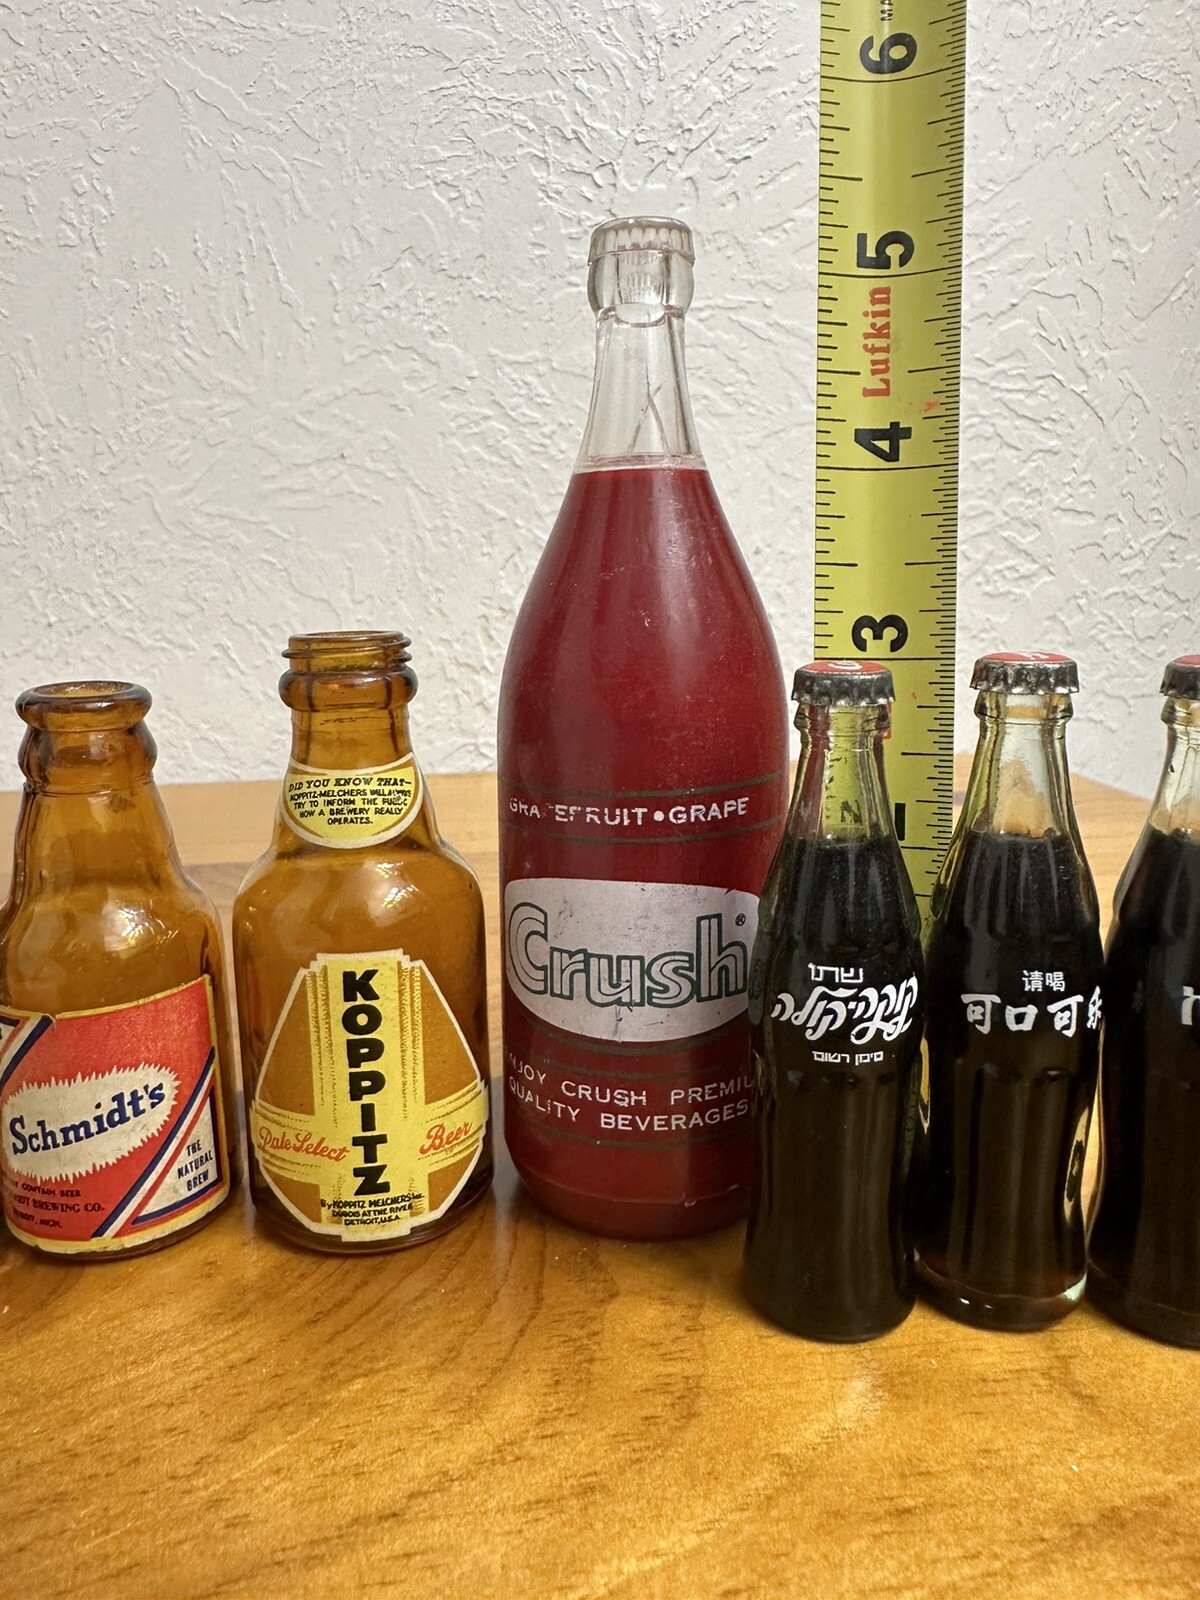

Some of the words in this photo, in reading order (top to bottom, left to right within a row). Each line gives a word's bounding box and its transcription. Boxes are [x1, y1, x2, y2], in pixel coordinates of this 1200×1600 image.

[860, 32, 917, 75] 6
[856, 230, 915, 270] 5
[862, 285, 892, 398] Lufkin
[854, 421, 912, 462] 4
[851, 614, 909, 653] 3
[288, 780, 303, 792] DID
[306, 778, 331, 789] YOU
[334, 777, 373, 787] KNOW
[370, 789, 387, 797] WILL
[293, 801, 307, 810] TRY
[323, 798, 356, 807] INFORM
[361, 798, 378, 806] THE
[299, 809, 315, 818] HOW
[329, 807, 370, 816] BREWERY
[375, 807, 403, 815] REALLY
[509, 797, 647, 826] GRAEFRUIT
[668, 797, 749, 824] GRAPE
[508, 902, 748, 1008] Crush
[808, 962, 864, 984] שתו
[1021, 970, 1066, 992] 请喝
[812, 1050, 850, 1063] רשום
[855, 1051, 884, 1066] סימן
[341, 969, 391, 1196] KOPPITZ
[508, 1051, 546, 1085] NJOY
[561, 1080, 647, 1107] CRUSH
[670, 1076, 752, 1105] PREMIU
[509, 1076, 580, 1122] QUALITY
[600, 1099, 749, 1131] BEVERAGES
[9, 1082, 166, 1156] Schmidt's
[187, 1139, 202, 1156] THE
[258, 1126, 292, 1151] Pale
[292, 1132, 348, 1163] Select
[419, 1121, 474, 1155] Beer
[177, 1150, 213, 1179] NATURAL
[187, 1169, 208, 1191] BREW
[33, 1198, 81, 1213] BREWING
[84, 1202, 105, 1213] CO.
